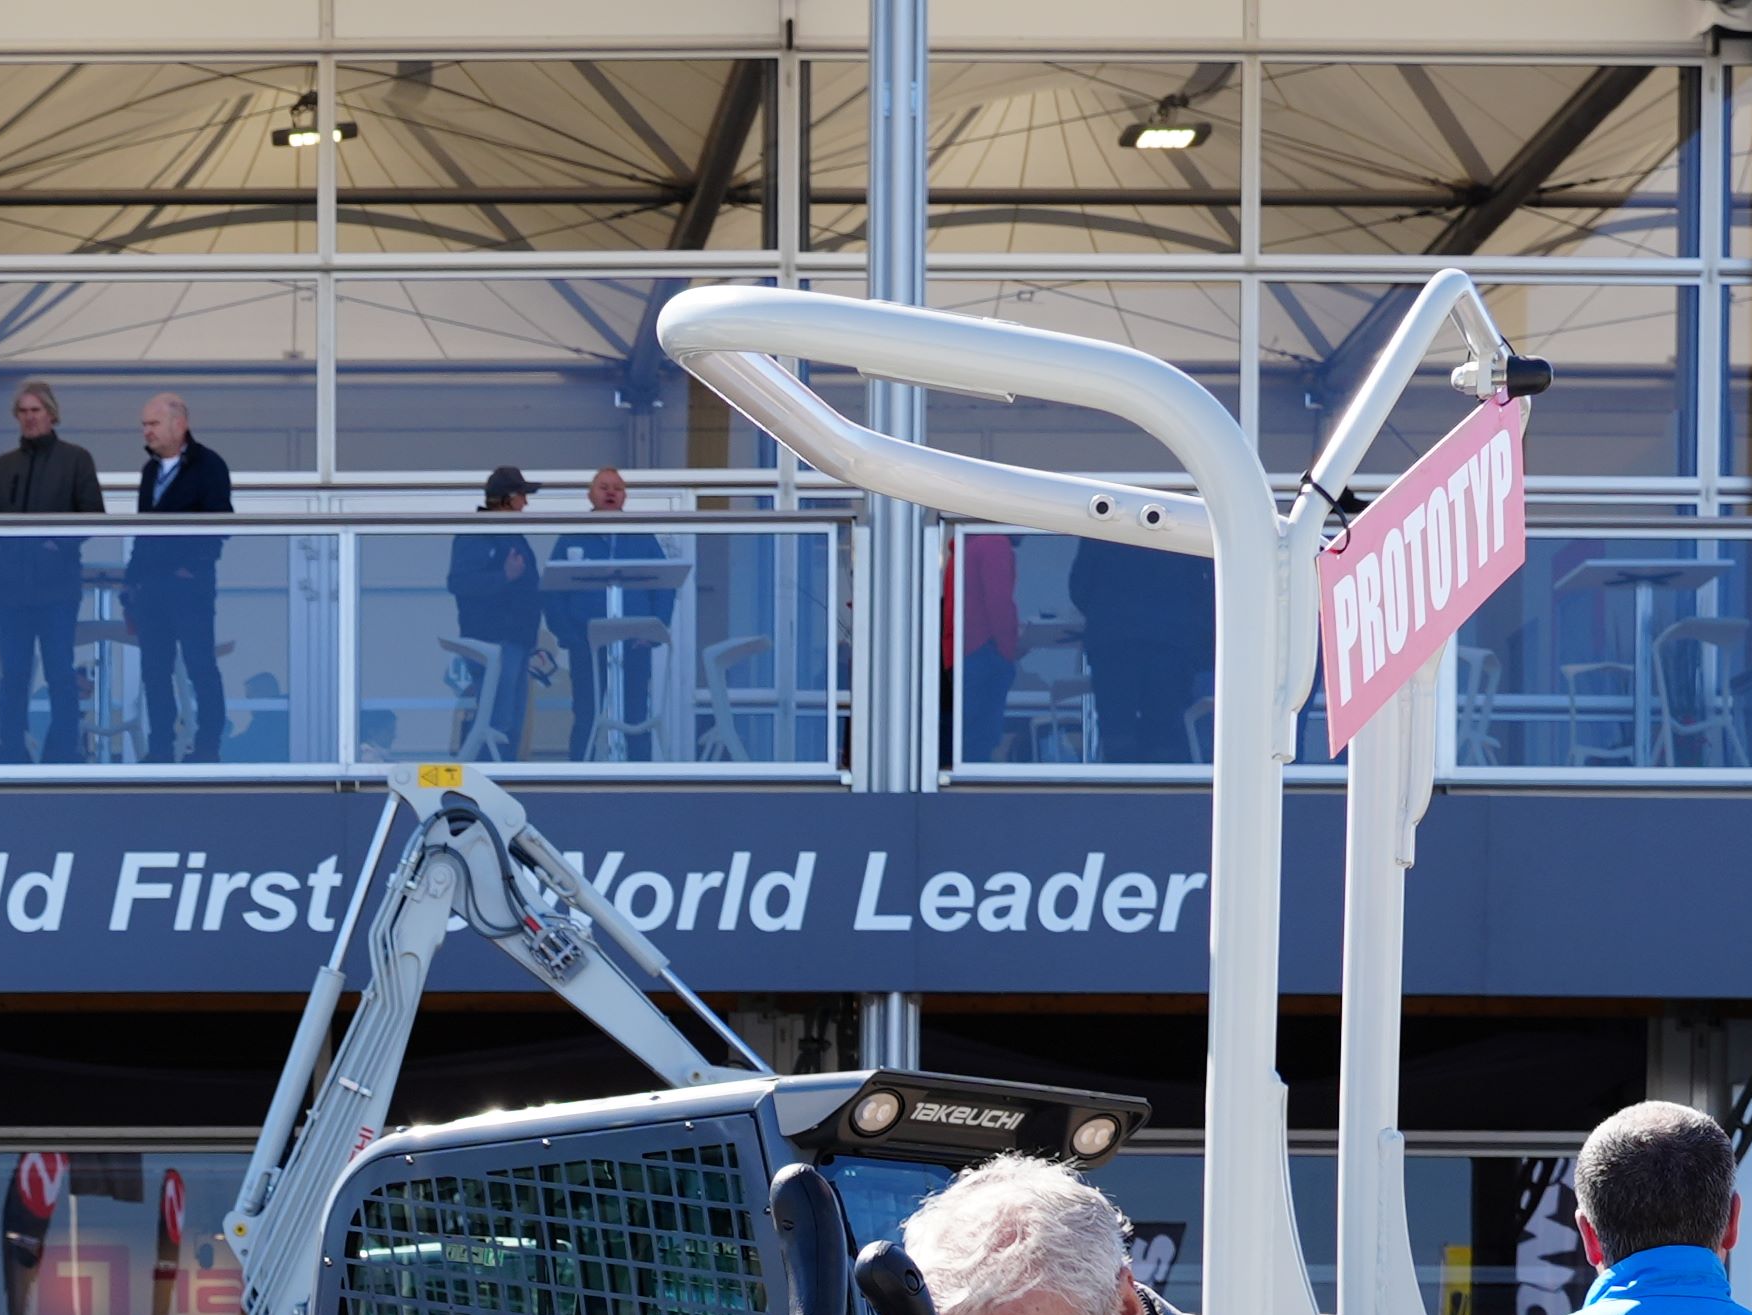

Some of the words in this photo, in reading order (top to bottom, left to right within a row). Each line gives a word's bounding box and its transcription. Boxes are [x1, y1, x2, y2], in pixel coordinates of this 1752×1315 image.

[1333, 429, 1512, 706] PROTOTYP
[109, 852, 342, 932] First
[852, 852, 1206, 932] Leader
[911, 1102, 1025, 1130] TAKEUCHI
